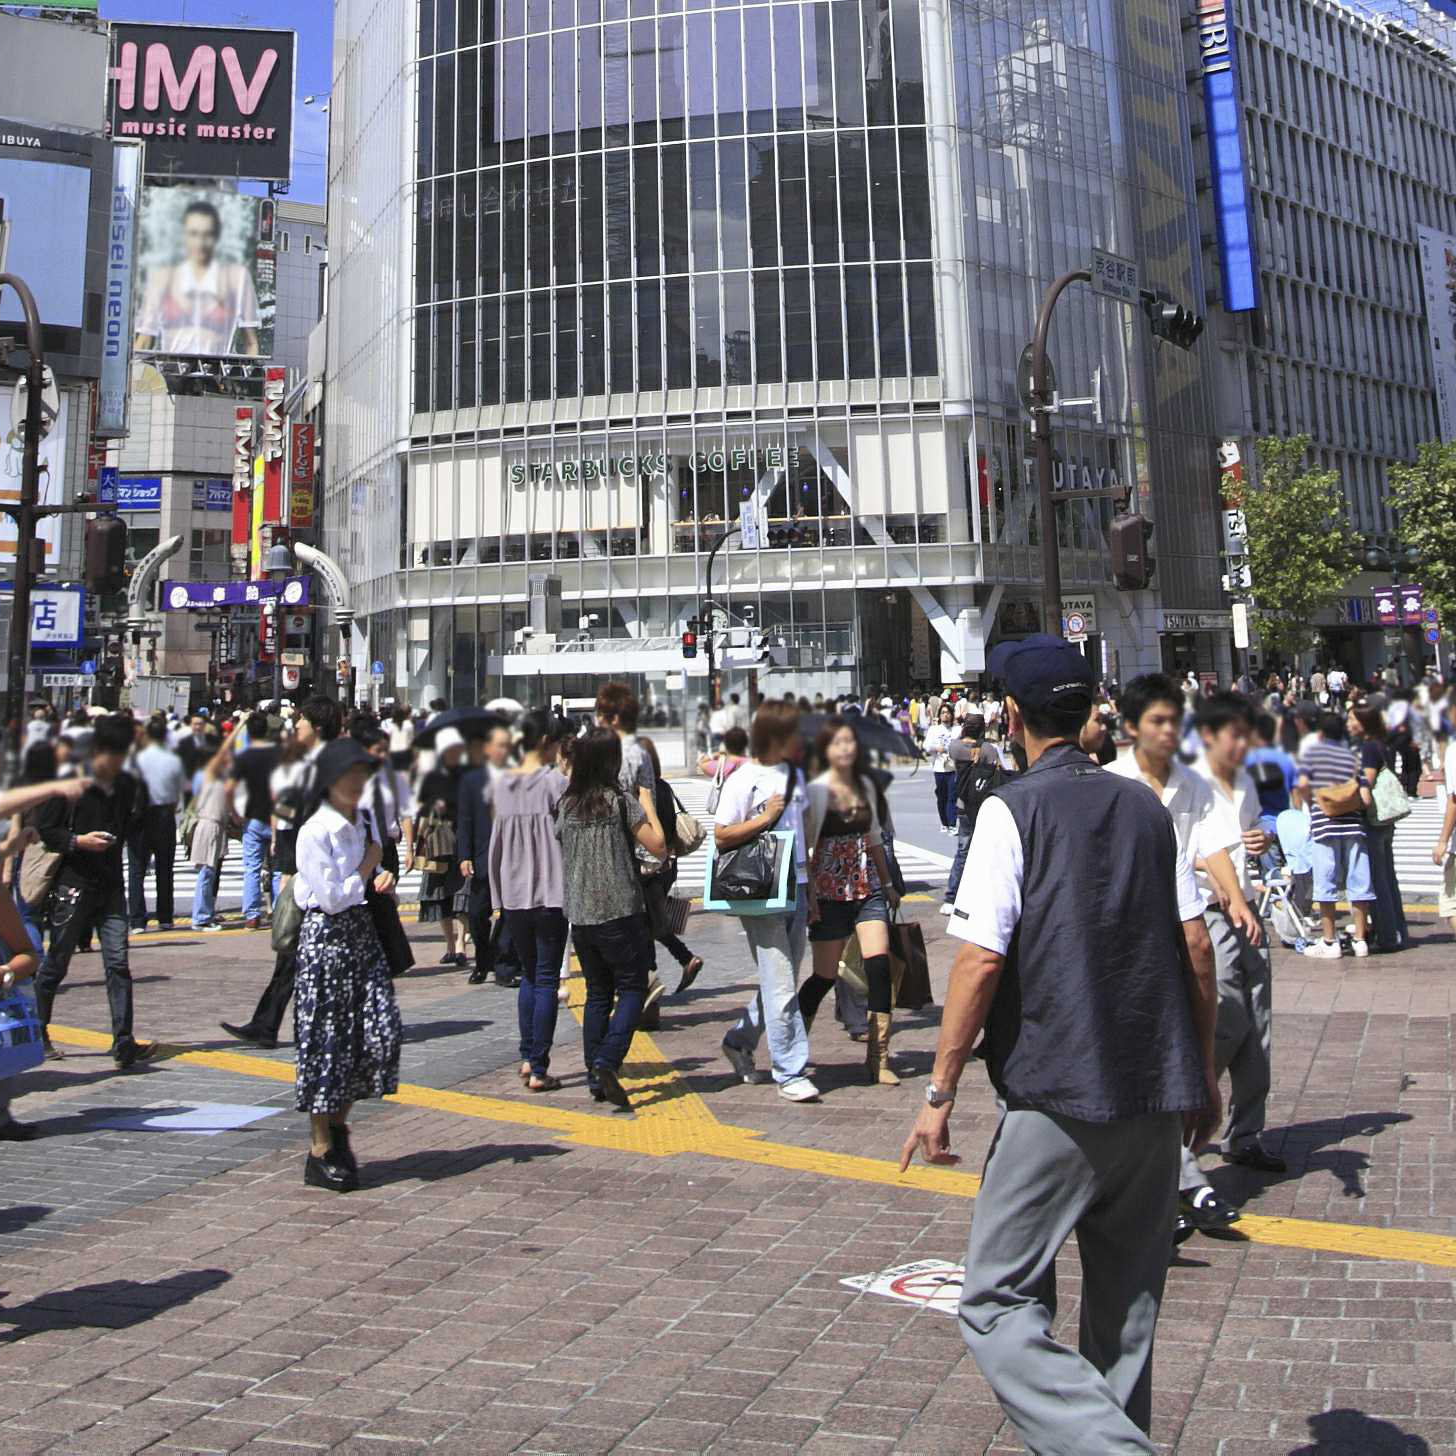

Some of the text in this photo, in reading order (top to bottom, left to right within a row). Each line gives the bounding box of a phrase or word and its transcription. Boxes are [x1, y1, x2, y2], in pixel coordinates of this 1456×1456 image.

[122, 118, 276, 141] music master
[104, 280, 128, 357] neon
[511, 446, 800, 486] STARBUCKS COFFEE
[1023, 458, 1124, 490] TUTAYA
